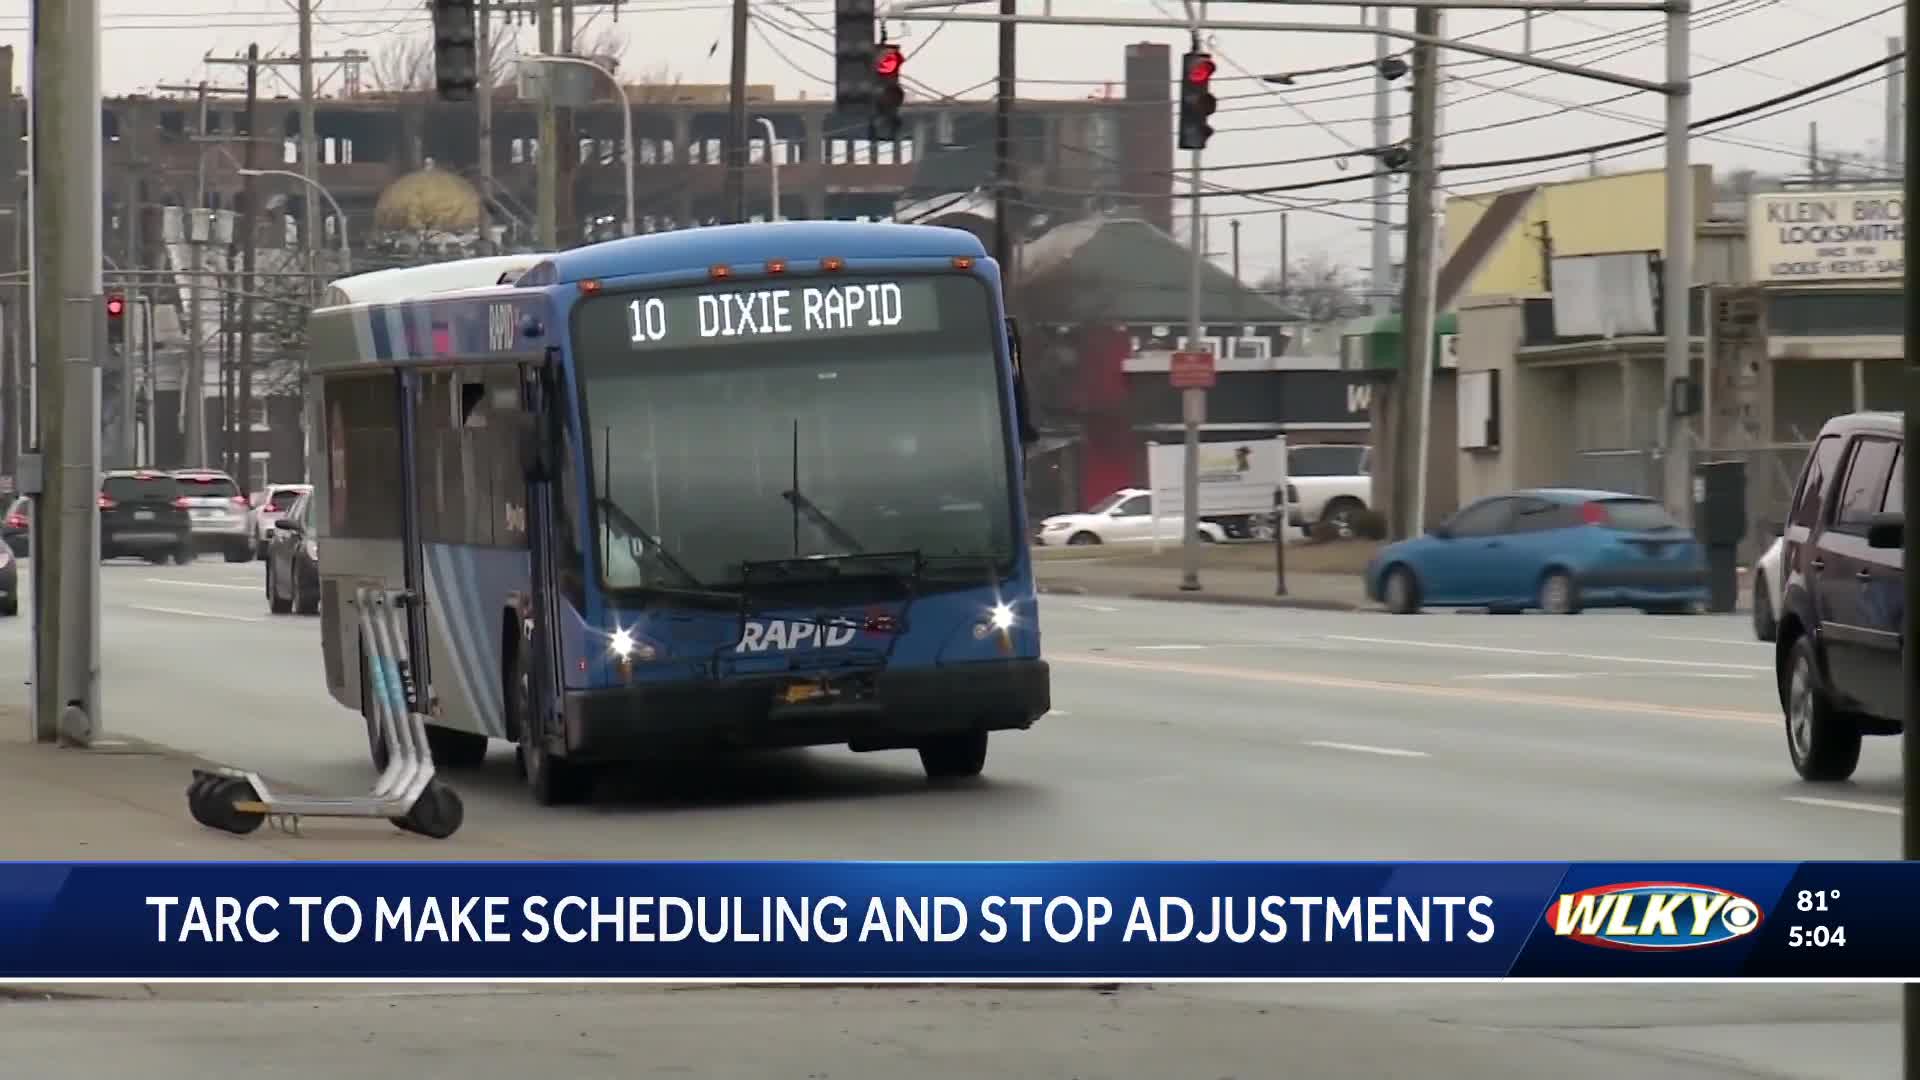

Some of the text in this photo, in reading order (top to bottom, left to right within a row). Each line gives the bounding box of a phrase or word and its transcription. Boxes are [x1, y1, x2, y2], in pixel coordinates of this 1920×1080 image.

[1767, 202, 1837, 223] KLEIN
[489, 303, 514, 352] RAPID
[629, 282, 903, 342] 10 DIXIE RAPID
[735, 617, 857, 653] RAPID
